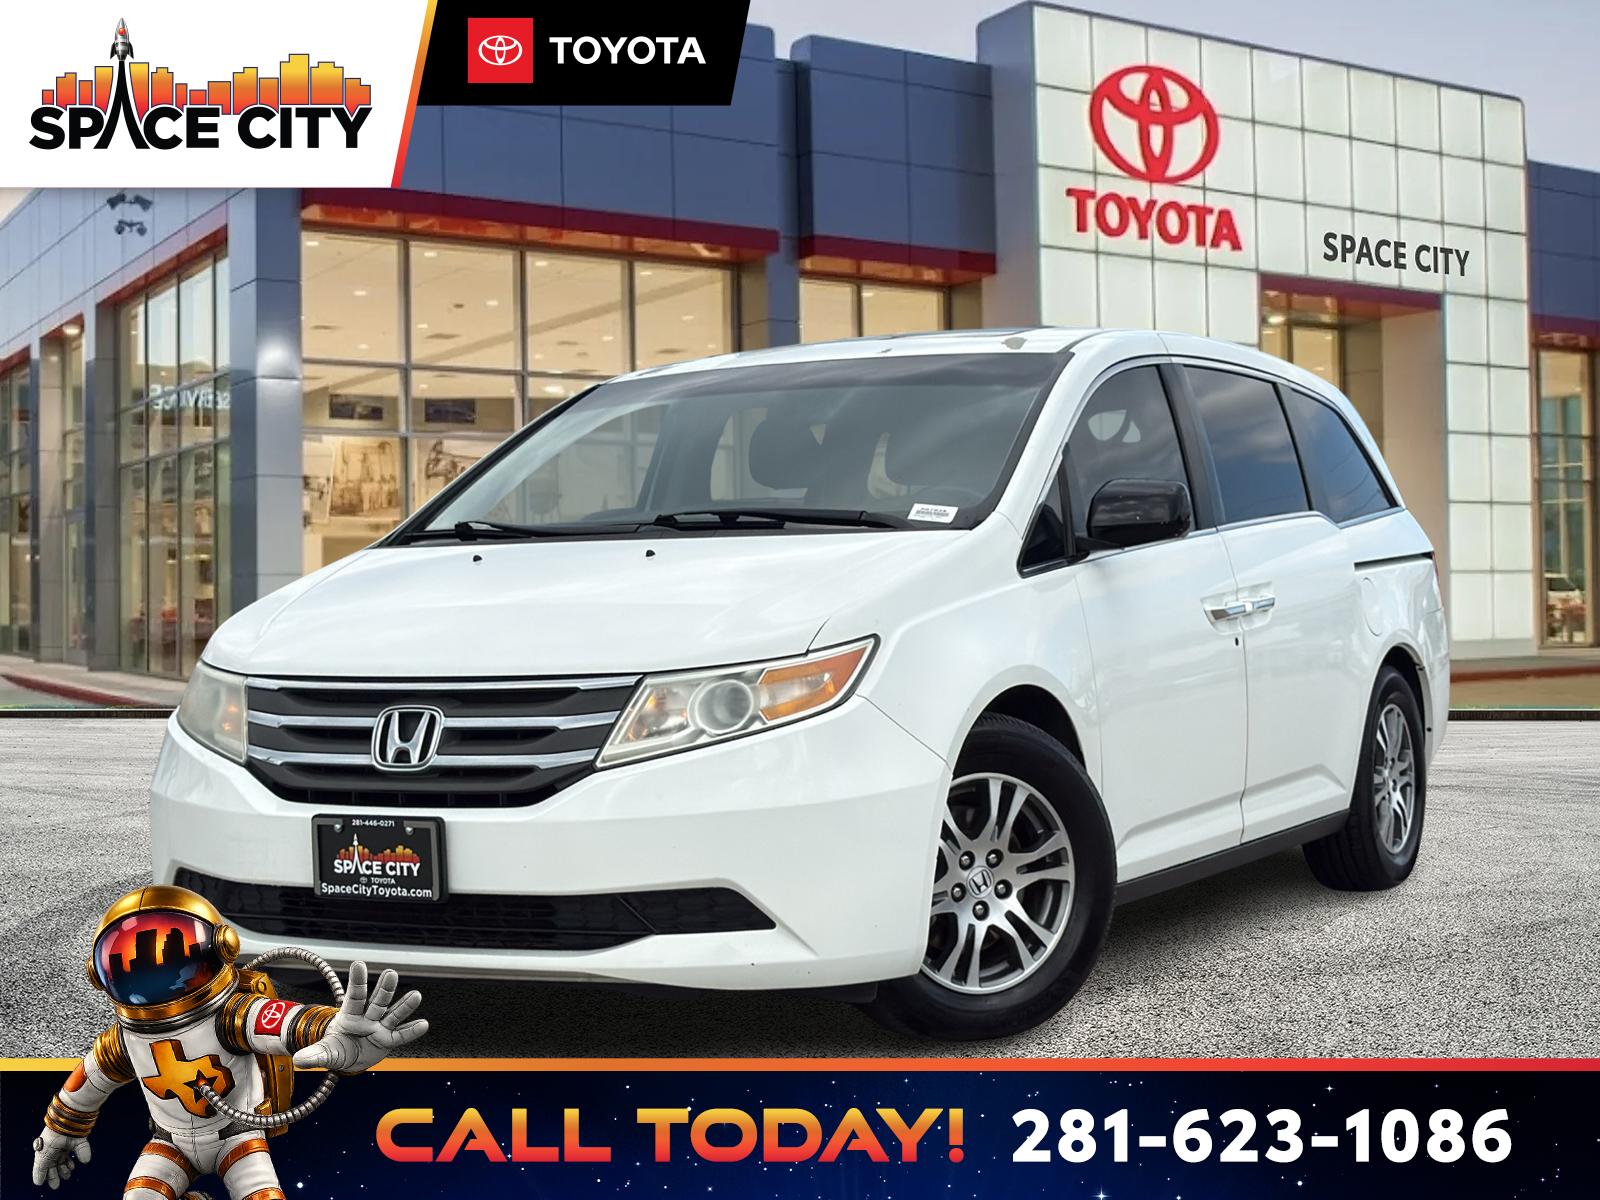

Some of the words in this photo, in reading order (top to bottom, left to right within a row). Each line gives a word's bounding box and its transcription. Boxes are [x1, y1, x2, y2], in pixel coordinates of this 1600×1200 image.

[1065, 187, 1243, 251] TOYOTA
[1323, 231, 1407, 270] SPACE
[1414, 243, 1470, 277] CITY
[334, 857, 382, 875] SPACE
[385, 861, 420, 876] CITY
[321, 882, 433, 898] SpaceCityToyota.com
[370, 876, 396, 885] TOYOTA
